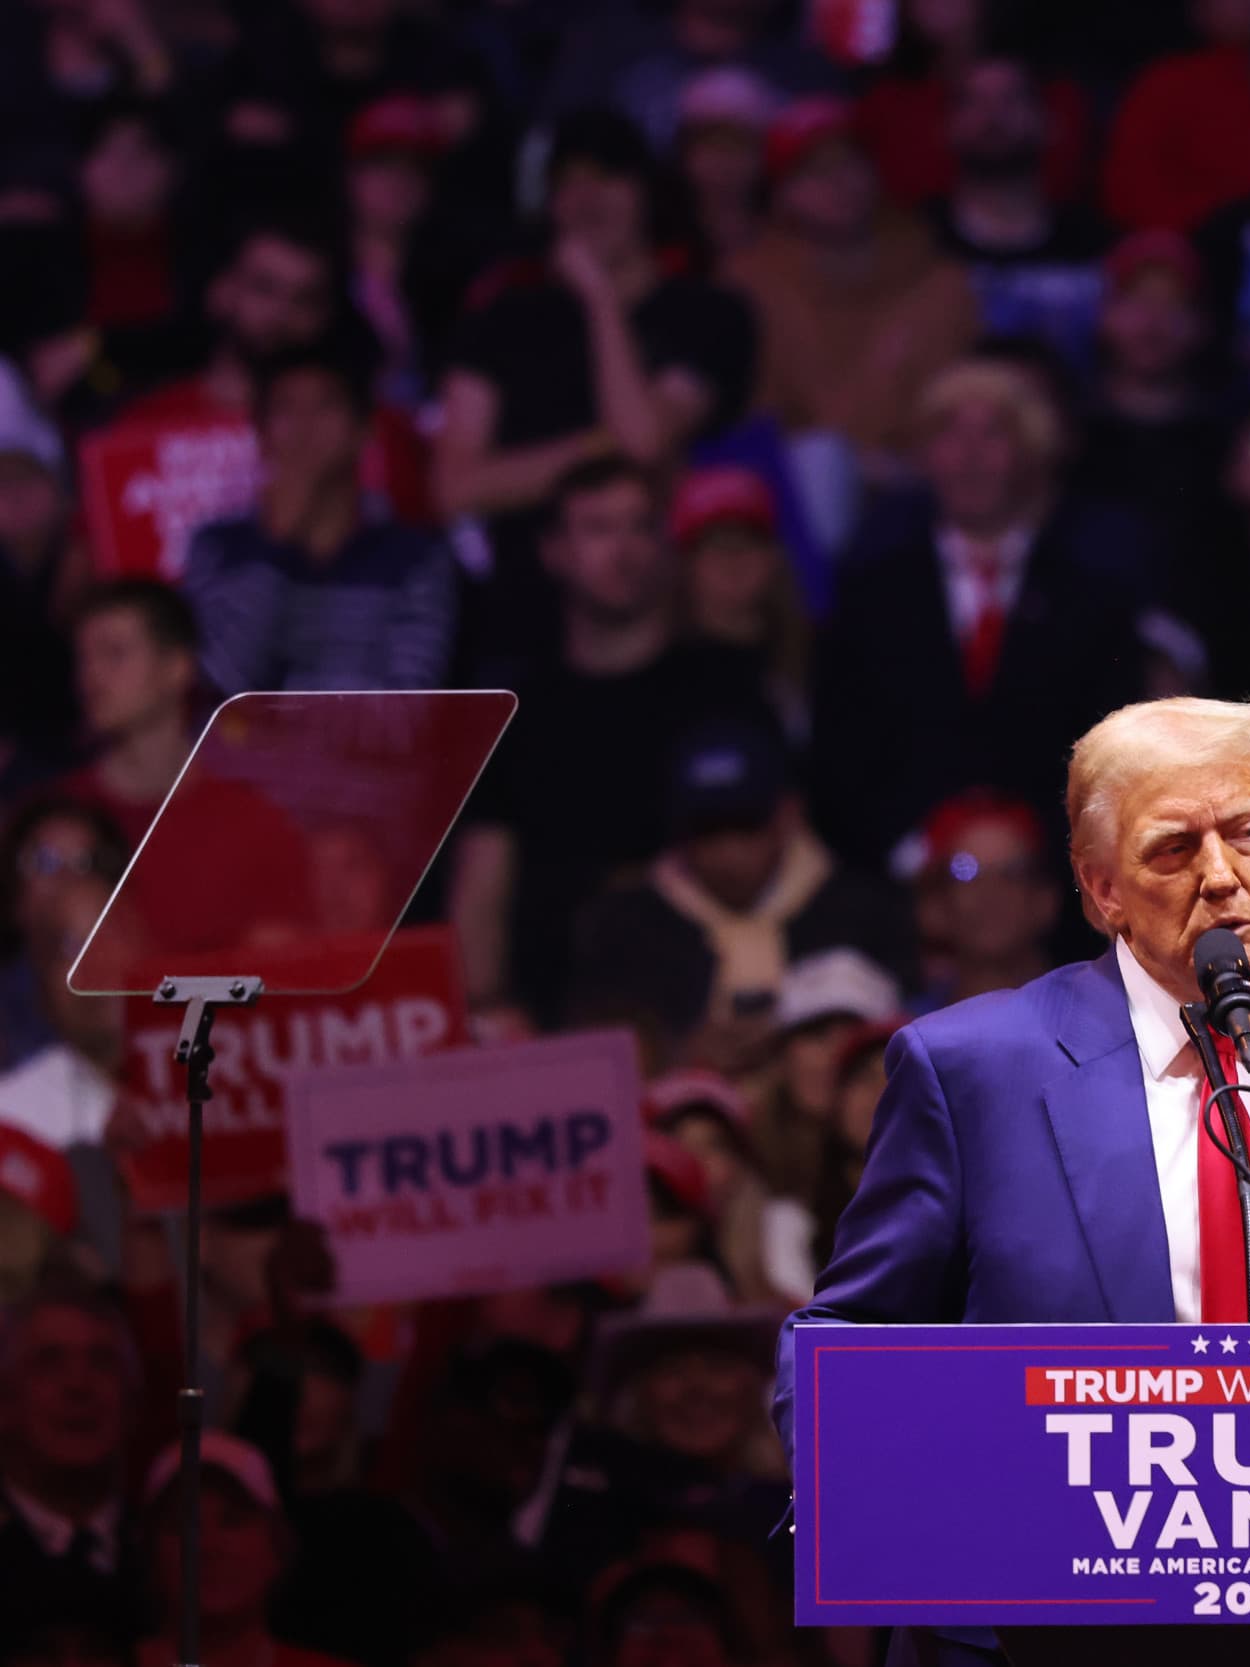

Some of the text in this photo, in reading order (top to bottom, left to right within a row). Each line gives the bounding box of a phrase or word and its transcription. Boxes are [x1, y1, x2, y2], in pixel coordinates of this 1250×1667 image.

[131, 996, 448, 1094] TRUMP
[323, 1111, 611, 1195] TRUMP
[332, 1168, 612, 1240] WILL FIX IT
[1045, 1369, 1204, 1402] TRUMP
[1072, 1557, 1141, 1575] MAKE
